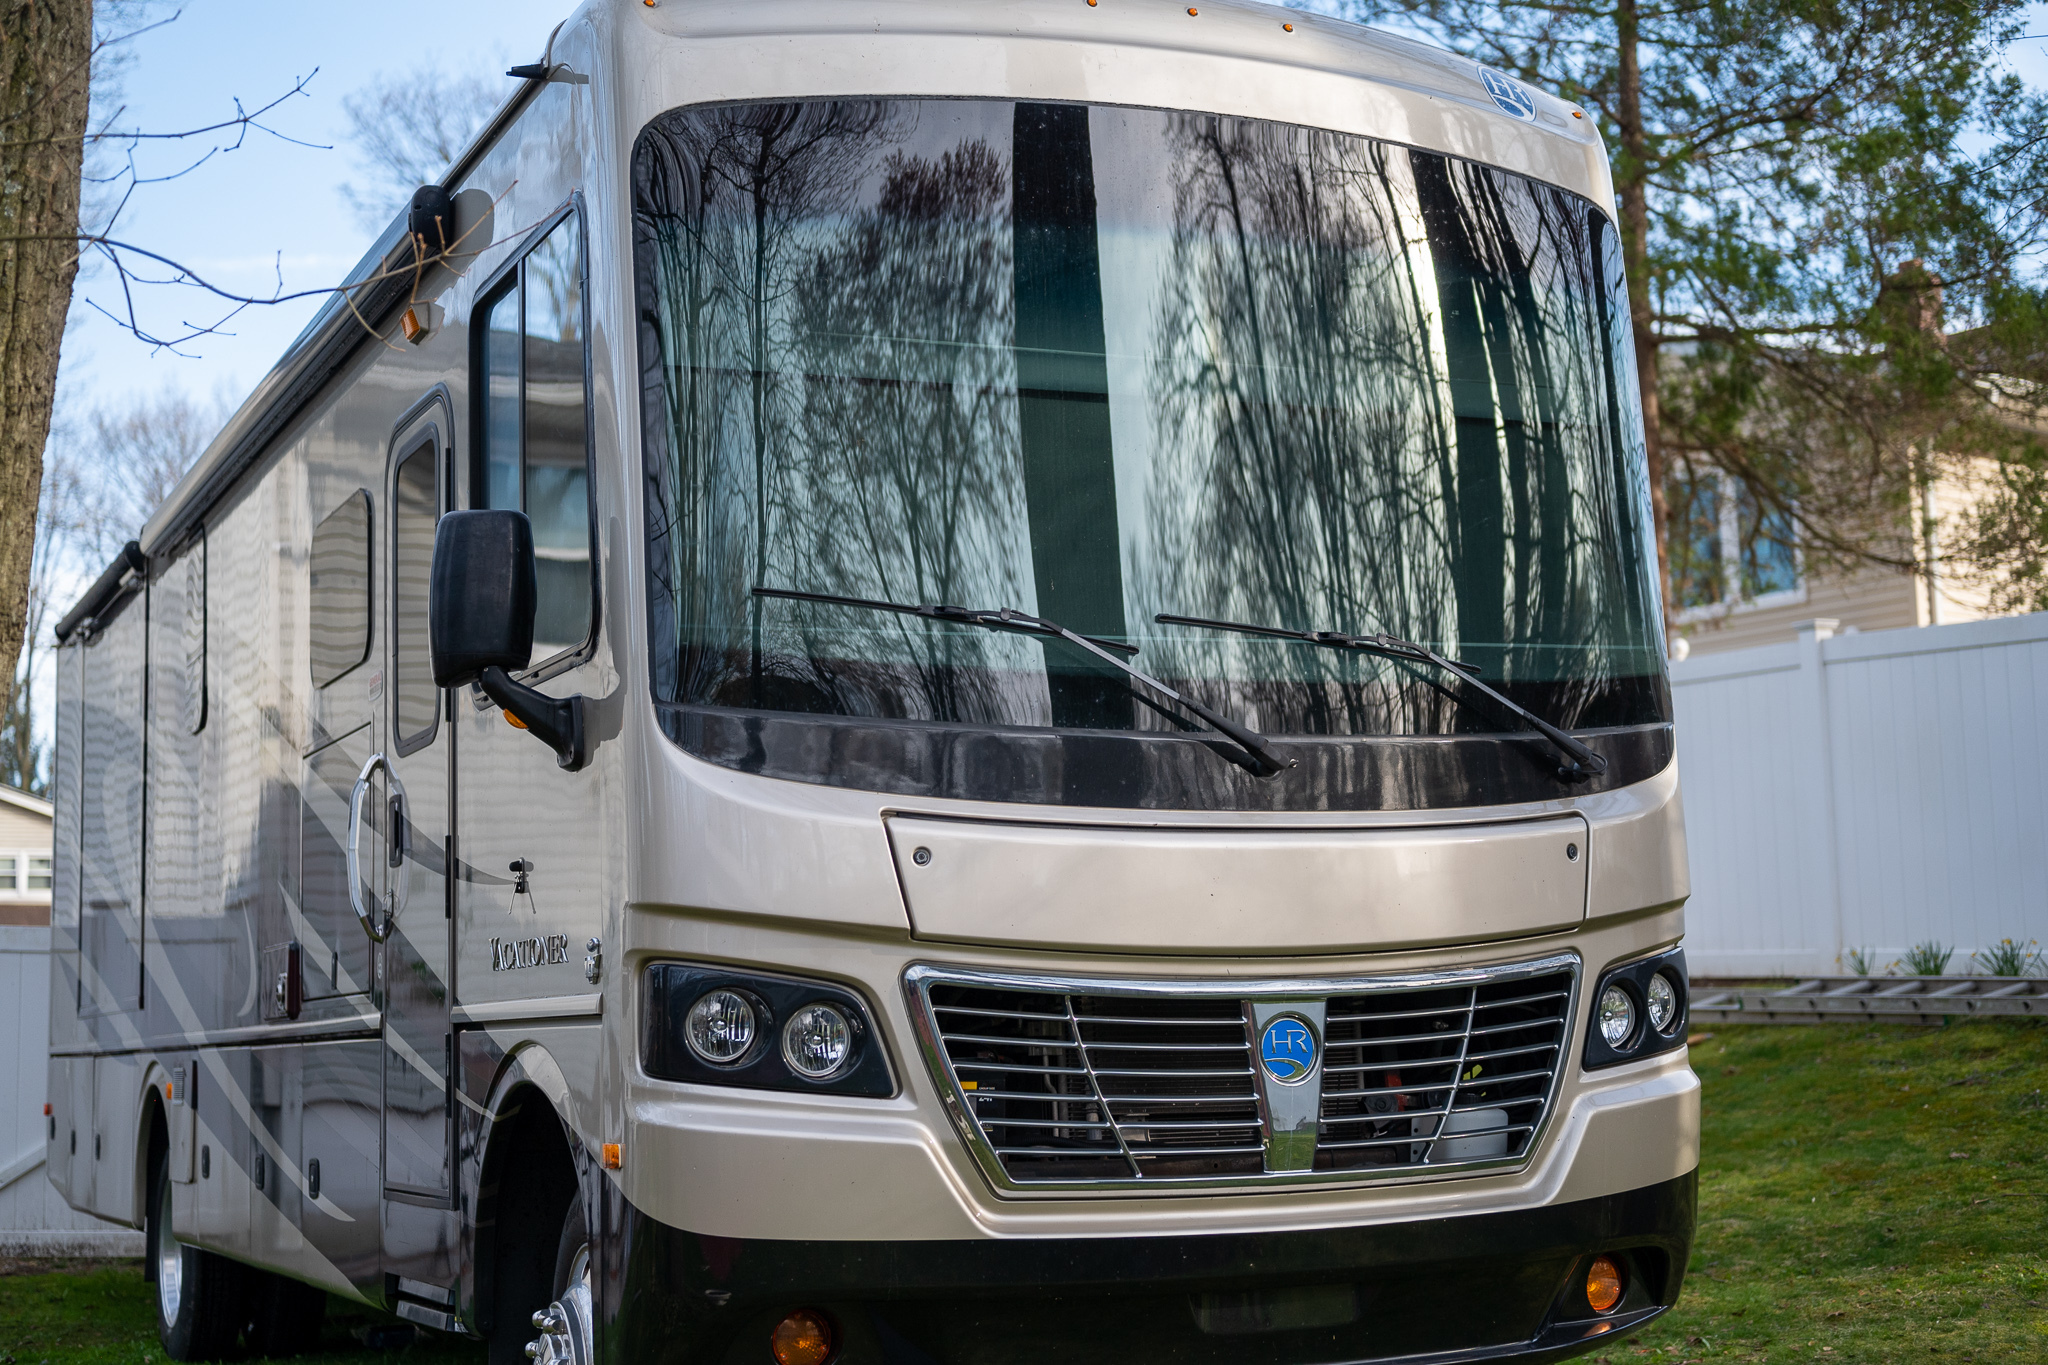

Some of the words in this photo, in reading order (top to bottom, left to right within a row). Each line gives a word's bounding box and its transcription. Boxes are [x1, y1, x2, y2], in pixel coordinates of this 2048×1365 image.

[1483, 71, 1531, 106] HR
[489, 933, 569, 971] VACATIONER
[1271, 1029, 1308, 1053] HR
